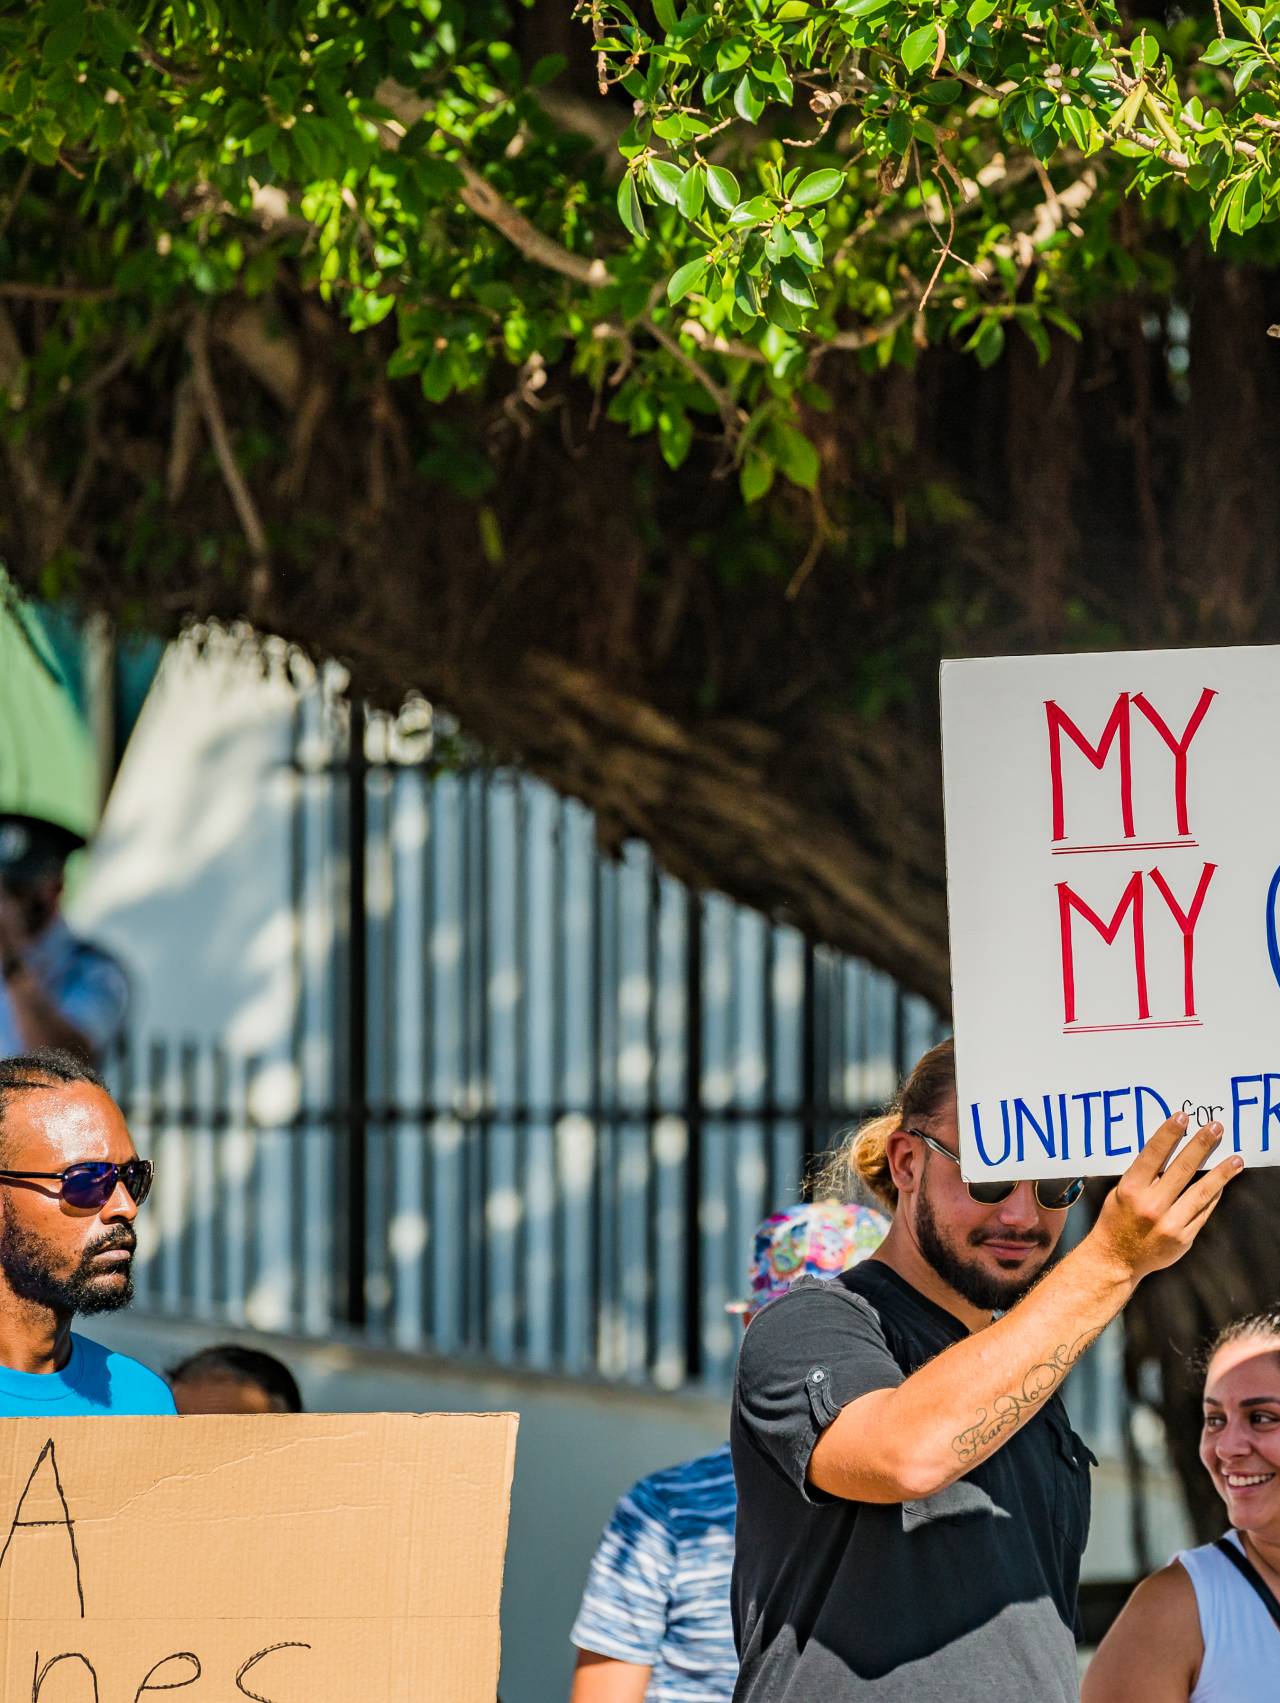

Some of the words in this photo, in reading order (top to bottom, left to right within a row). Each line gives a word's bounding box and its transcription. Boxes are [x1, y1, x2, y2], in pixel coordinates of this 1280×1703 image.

[1044, 686, 1217, 845] MY
[1055, 862, 1217, 1025] MY
[970, 1085, 1172, 1169] UNITED
[1182, 1099, 1224, 1137] for
